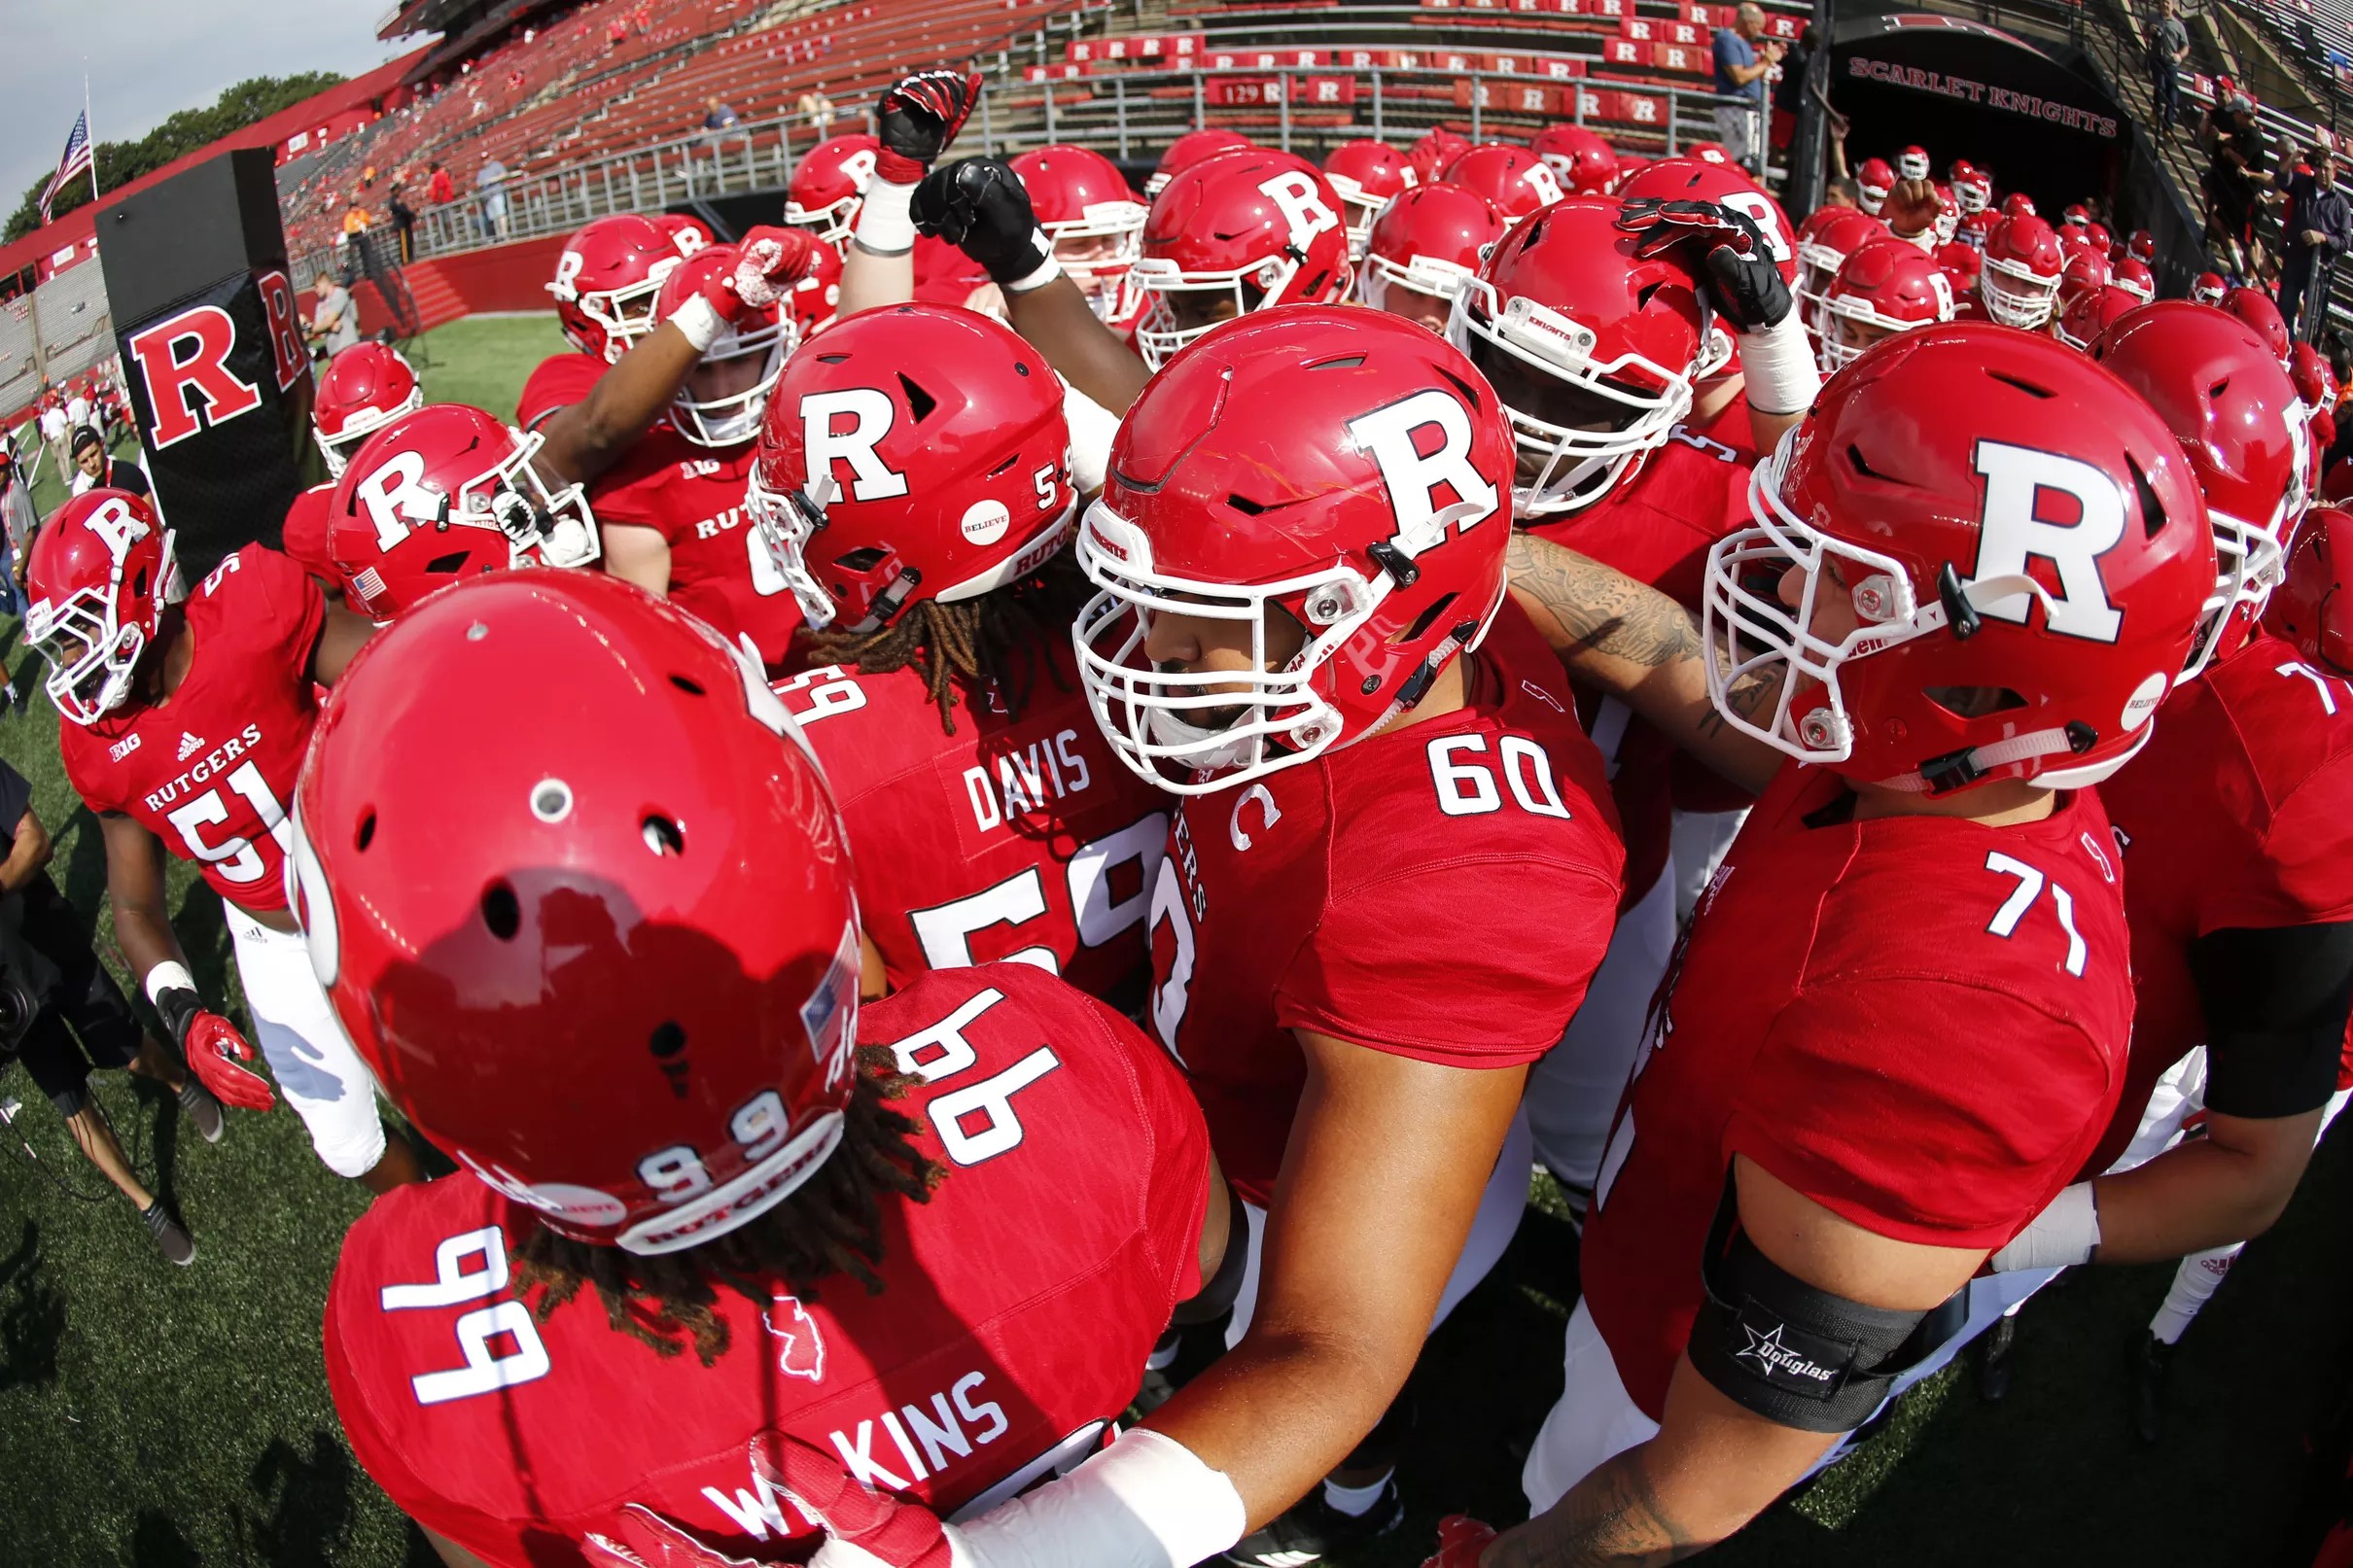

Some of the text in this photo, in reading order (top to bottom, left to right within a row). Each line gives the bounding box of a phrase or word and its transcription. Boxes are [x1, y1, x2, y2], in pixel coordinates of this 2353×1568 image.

[1631, 21, 1651, 40] R
[1676, 25, 1697, 44] R
[1691, 6, 1709, 24] R
[1775, 18, 1795, 37] R
[1616, 42, 1637, 62] R
[1667, 49, 1687, 69] R
[1225, 85, 1259, 103] 129
[1318, 82, 1340, 102] R
[1523, 88, 1545, 111] R
[1582, 93, 1600, 116] R
[1633, 99, 1656, 122] R
[1848, 56, 2118, 138] SCARLET KNIGHTS
[1257, 170, 1339, 251] R
[1528, 316, 1572, 341] KNIGHTS
[129, 304, 263, 451] R
[799, 387, 910, 504] R
[1346, 388, 1500, 561] R
[83, 497, 151, 567] R
[357, 450, 447, 553] R
[965, 515, 1007, 534] BELIEVE
[1961, 436, 2126, 645] R
[145, 723, 263, 813] RUTGERS
[962, 728, 1091, 833] DAVIS
[1426, 734, 1571, 819] 60
[166, 759, 293, 884] 51
[1230, 784, 1282, 852] C
[1984, 849, 2085, 980] 71
[635, 1087, 790, 1202] 99
[1757, 1341, 1834, 1380] Douglas
[700, 1371, 1009, 1542] WKINS
